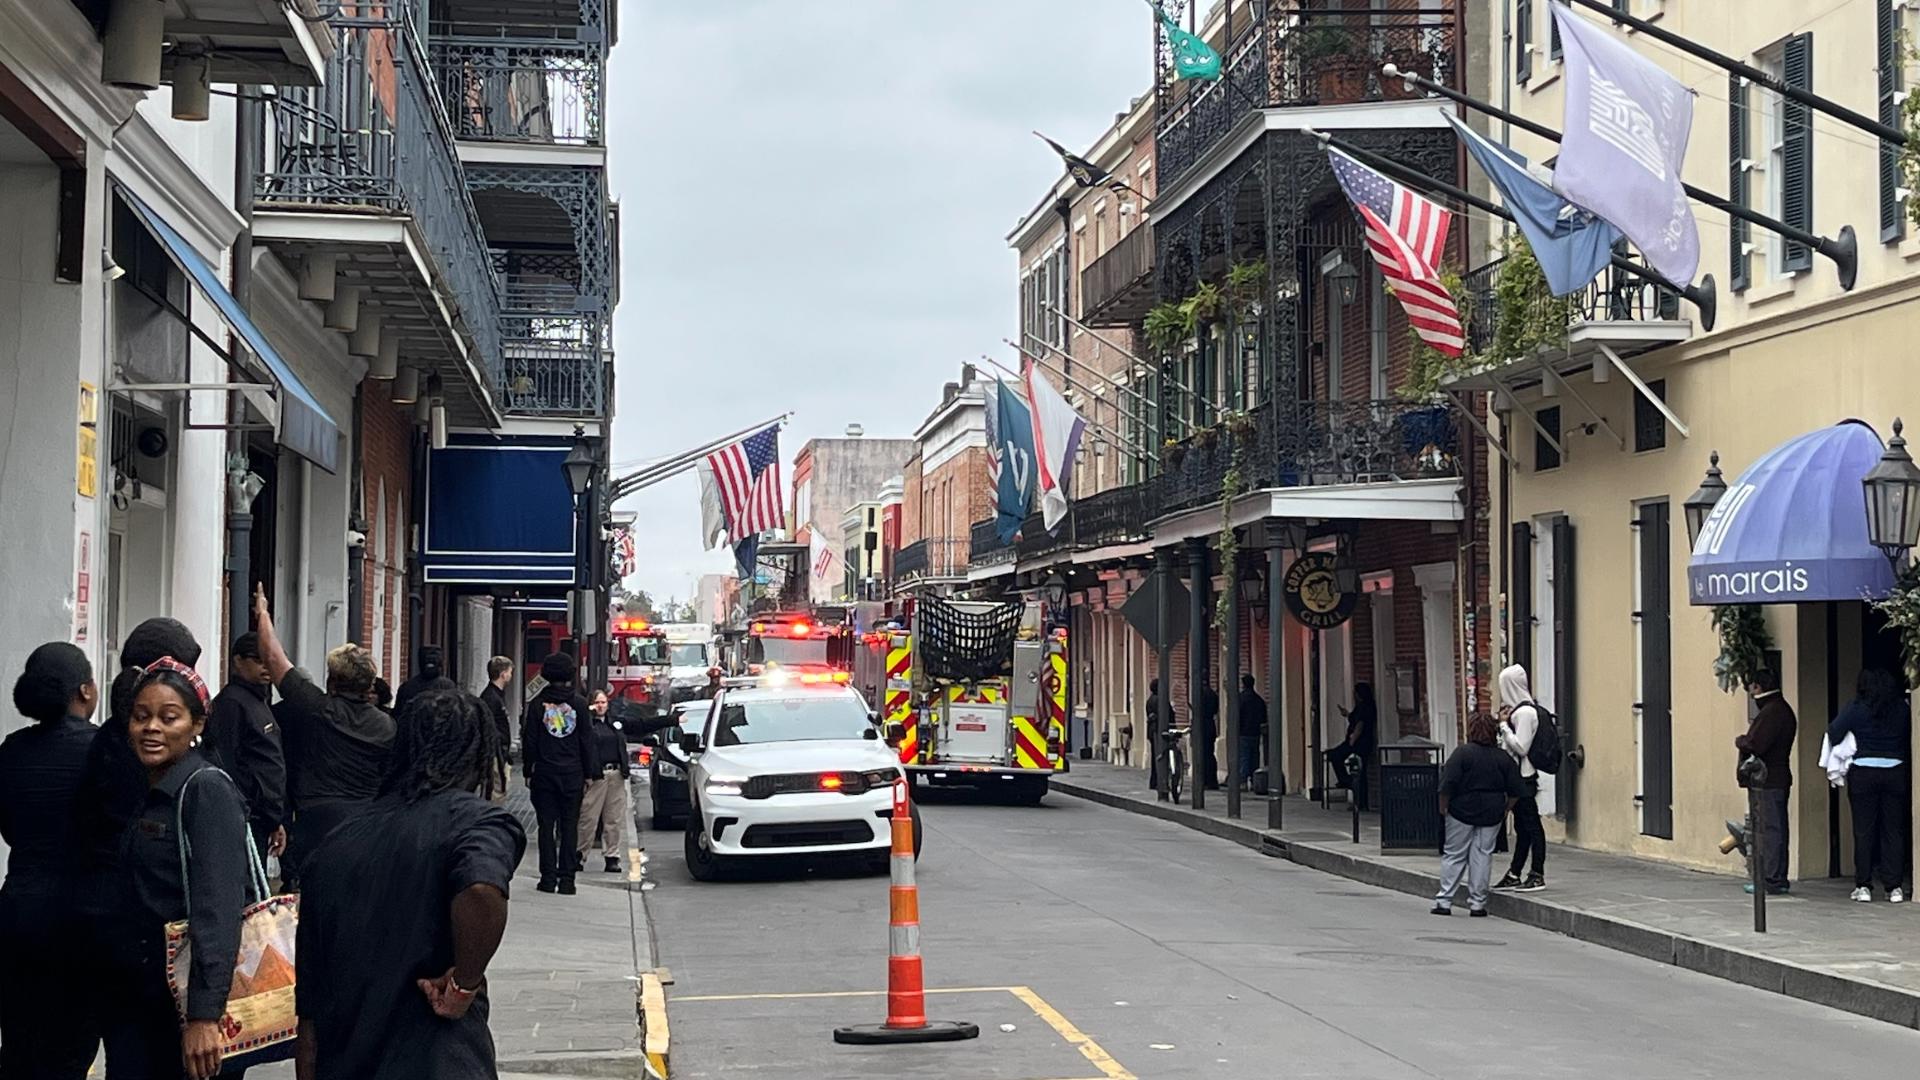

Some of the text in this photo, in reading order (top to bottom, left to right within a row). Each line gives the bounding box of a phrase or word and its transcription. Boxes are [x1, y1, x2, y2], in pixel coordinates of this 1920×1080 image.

[1286, 557, 1316, 592] COPPER
[1708, 561, 1808, 596] marais
[1300, 610, 1342, 625] GRILL
